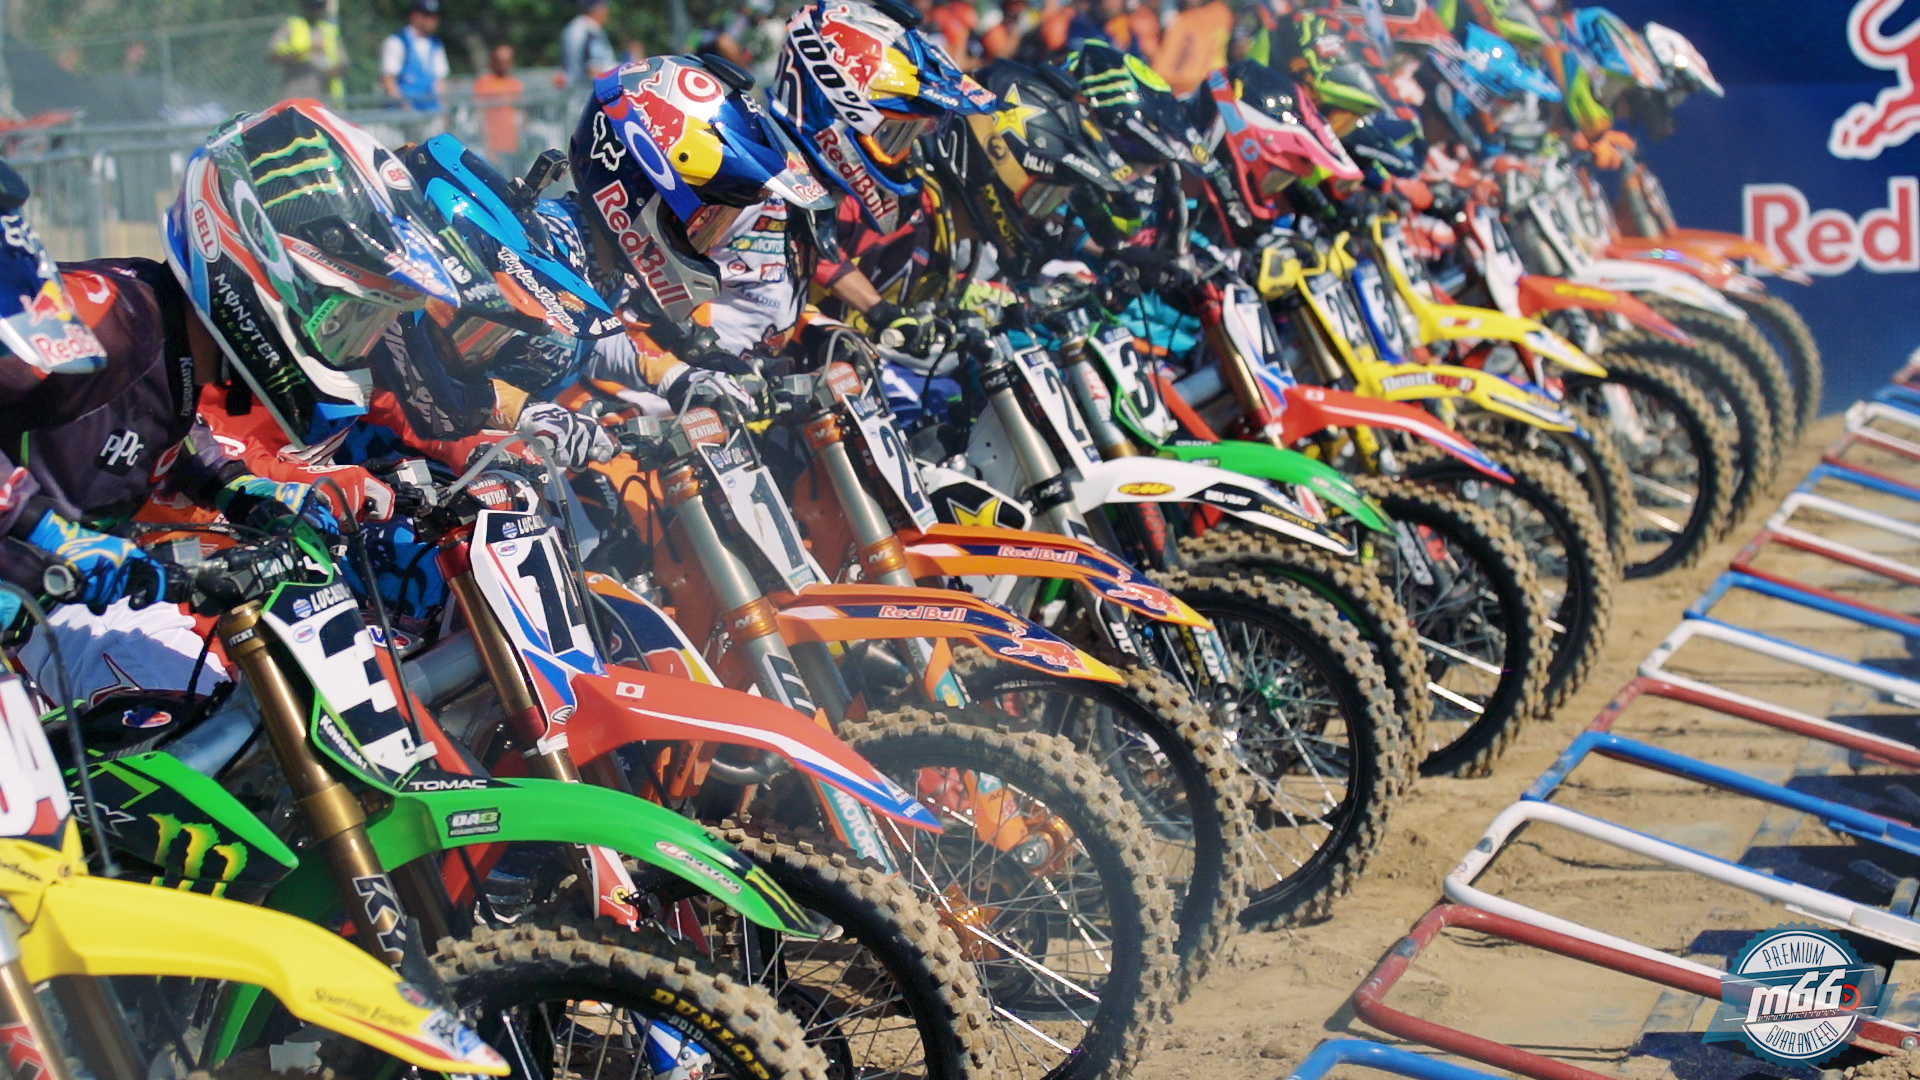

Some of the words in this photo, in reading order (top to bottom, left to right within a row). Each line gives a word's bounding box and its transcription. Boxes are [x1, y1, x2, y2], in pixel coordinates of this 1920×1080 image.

[791, 22, 871, 122] 100%
[814, 128, 865, 179] Red
[850, 173, 898, 221] Bull
[194, 206, 216, 253] BELL
[593, 180, 654, 253] Red
[633, 242, 693, 310] Bull
[1745, 179, 1917, 273] Red
[100, 430, 144, 467] PPG
[998, 546, 1037, 559] Red
[1037, 548, 1079, 564] Bull
[879, 605, 923, 619] Red
[922, 606, 967, 622] Bull
[318, 607, 415, 748] 3
[320, 714, 368, 770] Kawasaki
[409, 779, 488, 791] TOMAC
[352, 873, 407, 977] KY
